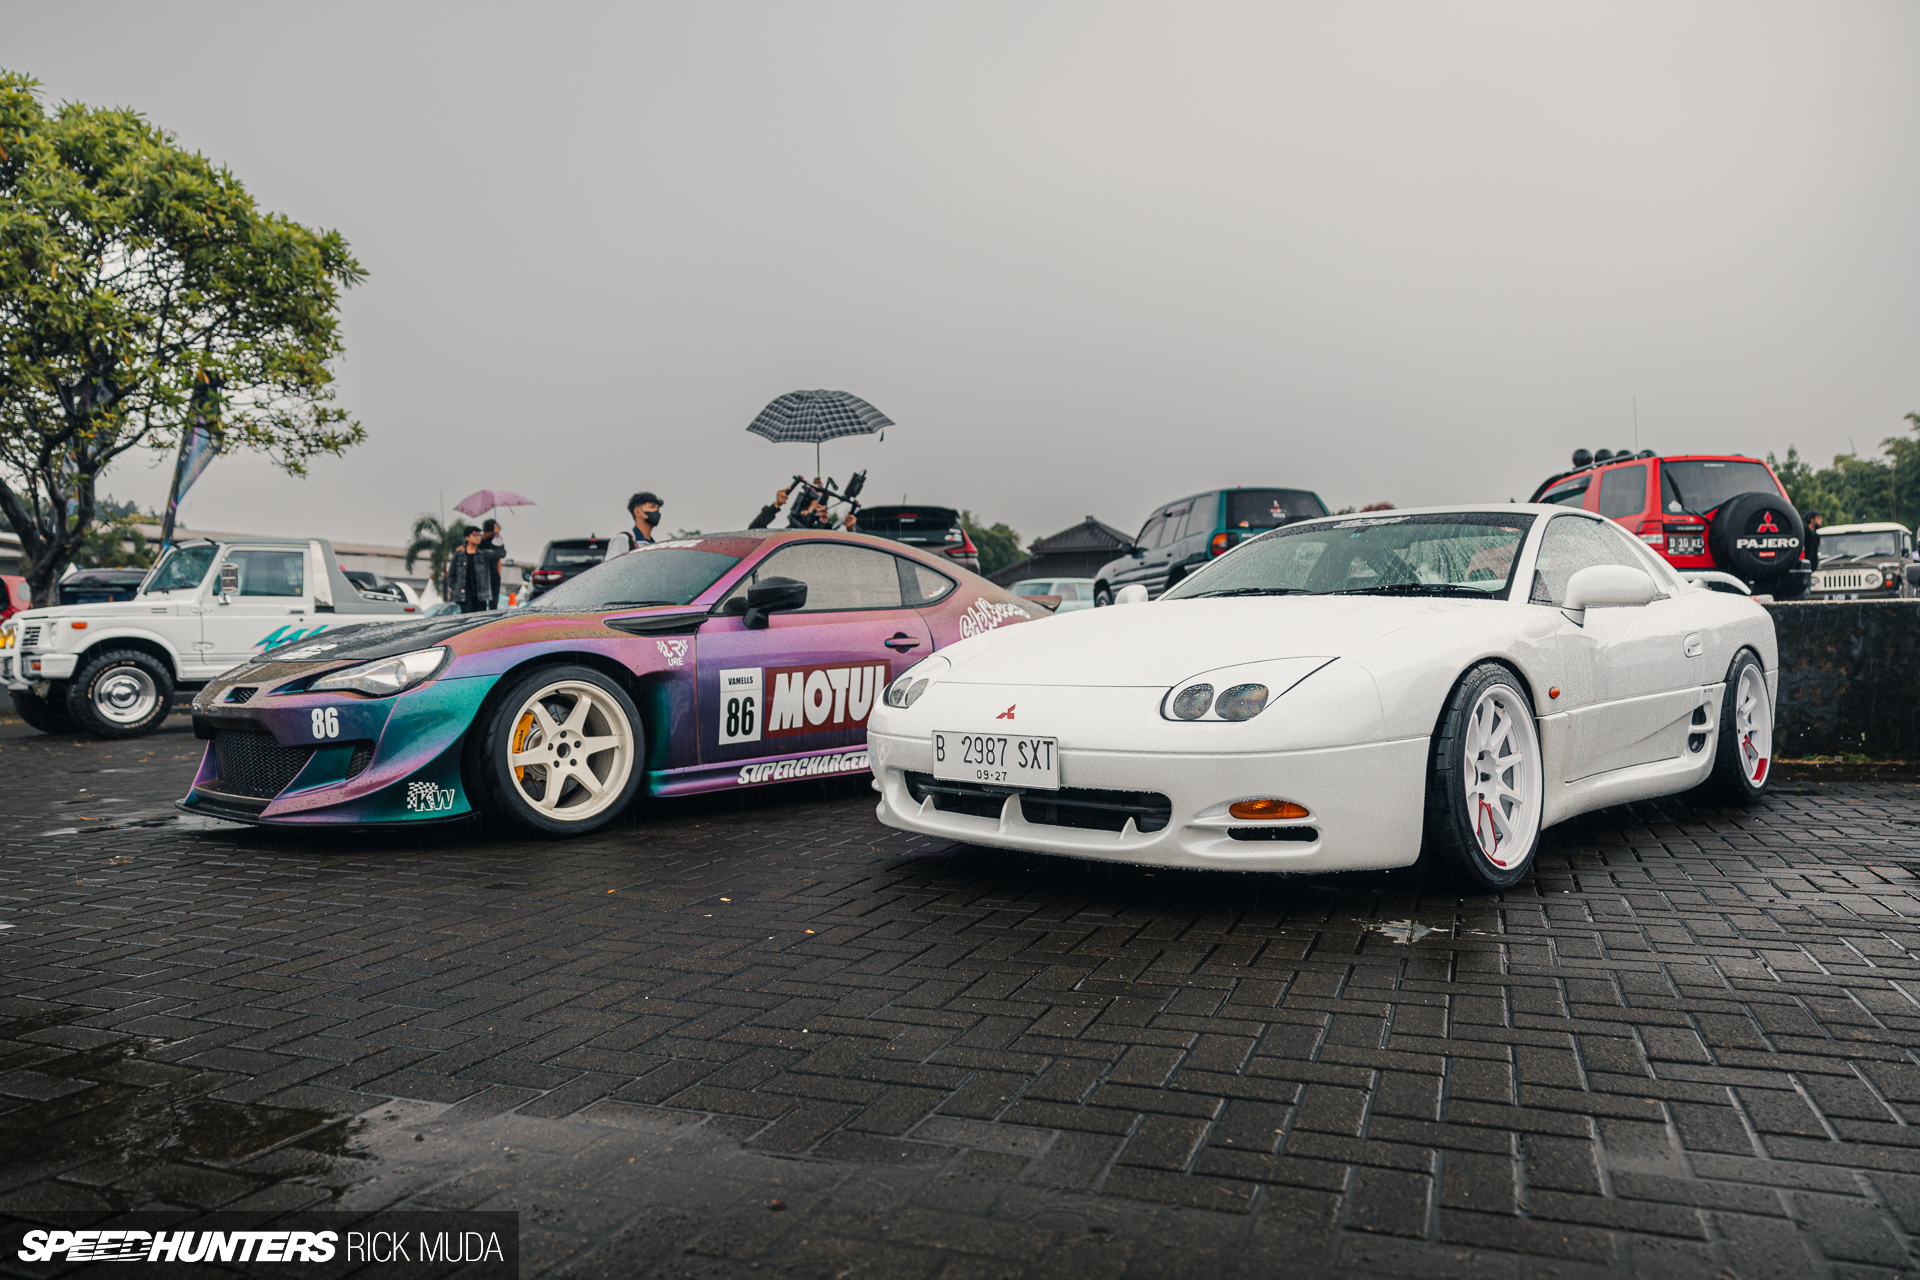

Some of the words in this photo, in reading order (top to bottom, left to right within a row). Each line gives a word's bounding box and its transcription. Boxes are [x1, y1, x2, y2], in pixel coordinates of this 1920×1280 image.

[1736, 538, 1800, 549] PAJERO
[668, 658, 684, 667] URE
[728, 676, 753, 686] VAMELLS
[311, 707, 340, 739] 86
[726, 696, 755, 737] 86
[936, 735, 945, 761] B
[963, 736, 1008, 766] 2987
[1018, 740, 1054, 770] SXT
[737, 750, 871, 784] SUPERCHARGED
[414, 789, 456, 812] KW
